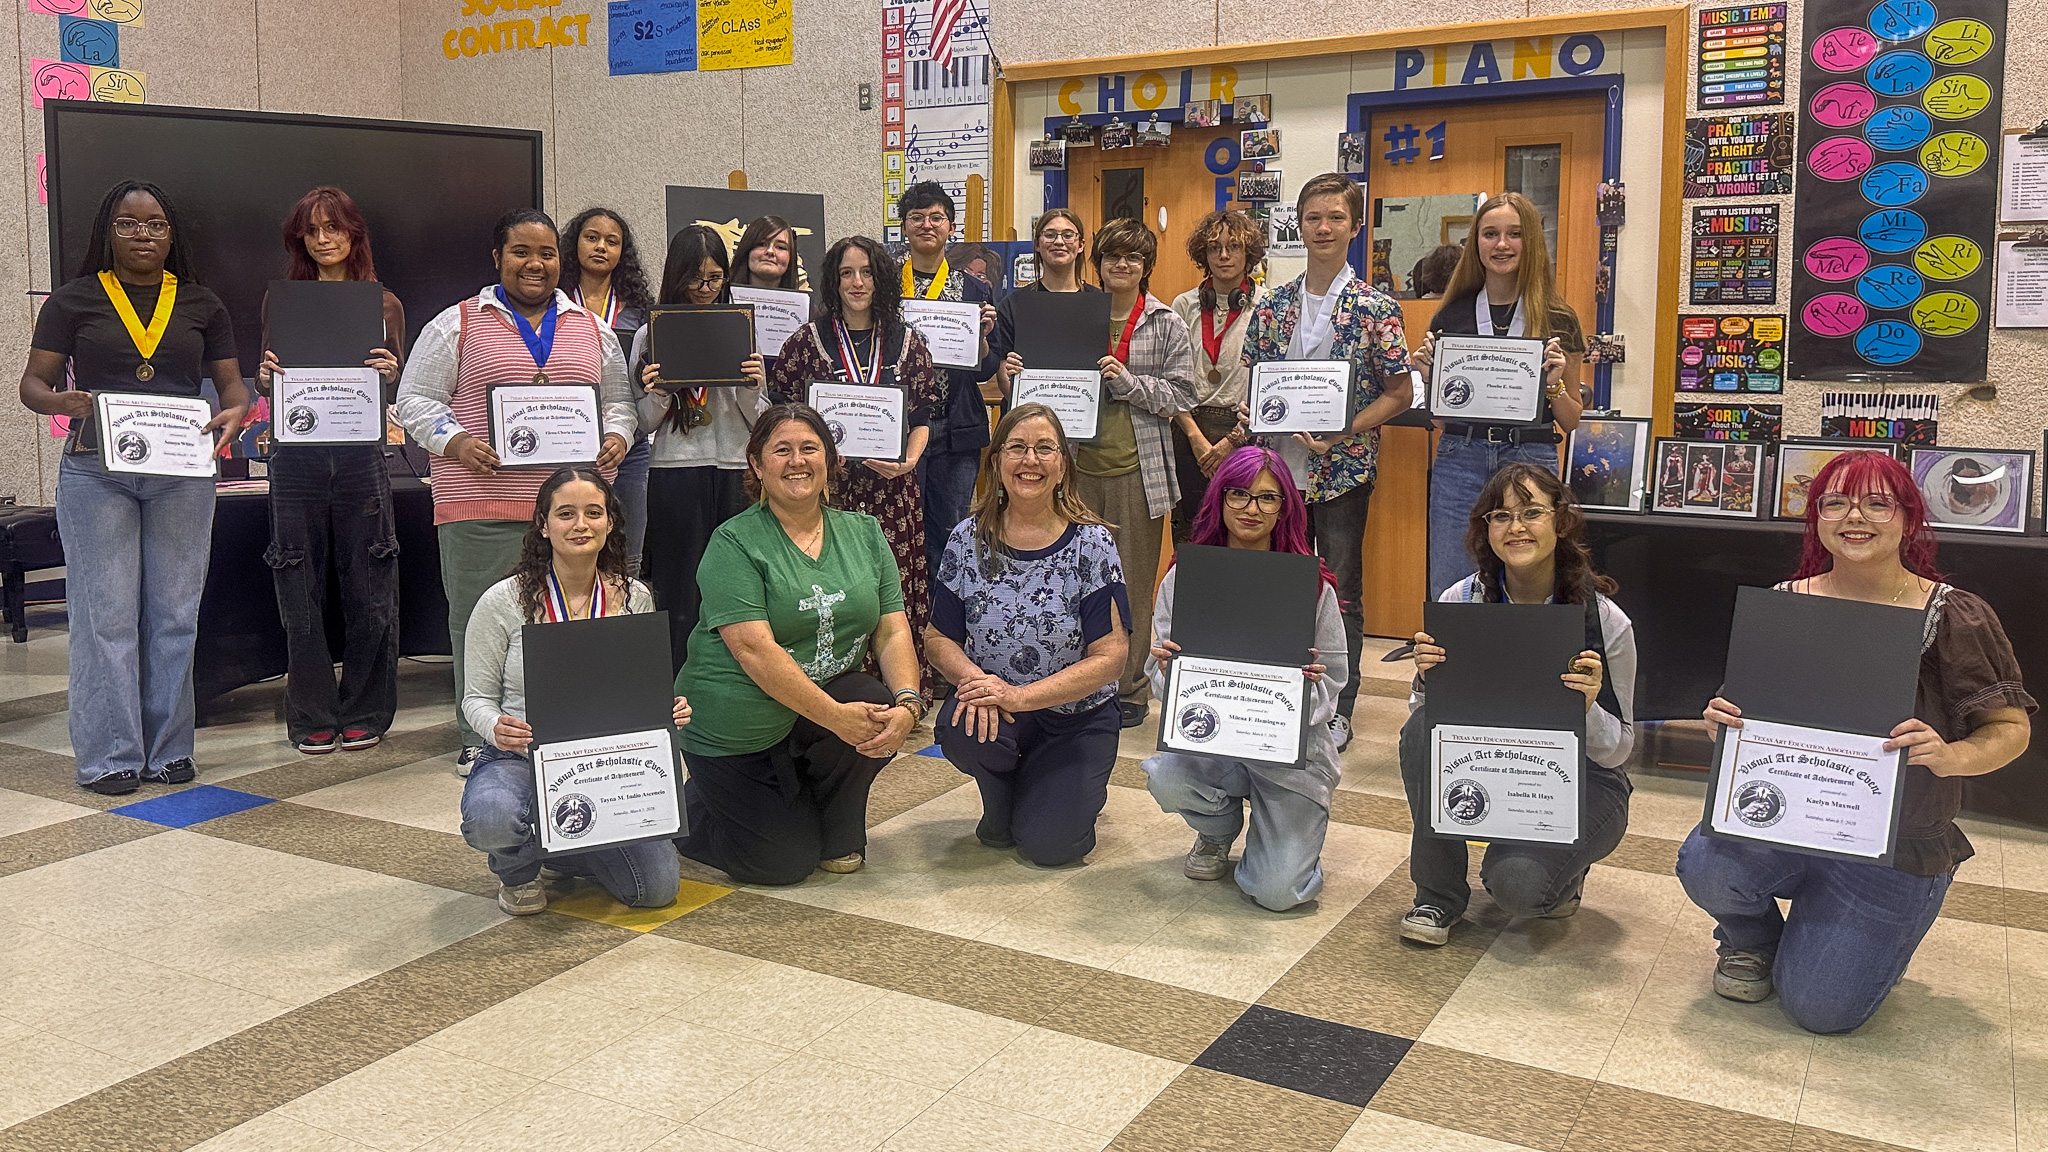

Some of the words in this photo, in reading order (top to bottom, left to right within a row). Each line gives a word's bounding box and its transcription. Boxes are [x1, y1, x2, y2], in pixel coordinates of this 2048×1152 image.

[1701, 10, 1740, 25] MUSIC
[1743, 6, 1785, 21] TEMPO
[1902, 2, 1920, 16] Ti
[443, 13, 591, 60] CONTRACT
[1961, 25, 1980, 39] Li
[1849, 33, 1866, 46] Te
[82, 45, 100, 60] La
[1394, 33, 1605, 91] PIANO
[108, 74, 122, 88] Si
[1892, 79, 1914, 92] La
[1940, 80, 1959, 94] Si
[1058, 65, 1238, 115] CHOIR
[1891, 109, 1913, 122] So
[1707, 121, 1769, 137] PRACTICE
[1383, 120, 1447, 165] #1
[1709, 137, 1729, 146] UNTIL
[1730, 136, 1744, 144] YOU
[1745, 135, 1759, 143] GET
[1958, 137, 1977, 151] Fi
[1722, 144, 1754, 157] RIGHT
[1707, 160, 1769, 175] PRACTICE
[1846, 159, 1866, 173] Se
[1697, 175, 1717, 183] UNTIL
[1733, 174, 1754, 182] CAN'T
[1771, 172, 1778, 180] IT
[1716, 182, 1760, 195] WRONG!
[1899, 178, 1923, 193] Fa
[1711, 217, 1760, 233] MUSIC
[1881, 212, 1906, 227] Mi
[1950, 244, 1973, 258] Ri
[1890, 272, 1917, 286] Re
[1835, 302, 1859, 315] Ra
[1943, 299, 1967, 313] Di
[1877, 324, 1905, 339] Do
[1716, 340, 1745, 353] WHY
[1443, 358, 1465, 373] Visual
[1481, 354, 1518, 365] Scholastic
[1519, 362, 1536, 379] Event
[1706, 355, 1754, 368] MUSIC?
[1707, 409, 1749, 423] SORRY
[190, 419, 203, 431] Eve
[1849, 421, 1905, 438] MUSIC
[1705, 431, 1749, 440] NOISE
[1180, 681, 1208, 699] Visual
[1210, 680, 1225, 688] Art
[1228, 680, 1273, 696] Scholastic
[1274, 692, 1295, 712] Event
[1204, 692, 1232, 700] Certificate
[1255, 718, 1286, 727] Hemingway
[1443, 753, 1473, 775] Visual
[1475, 750, 1492, 760] Art
[1494, 749, 1545, 766] Scholastic
[1547, 761, 1572, 784] Event
[1469, 765, 1500, 773] Certificate
[1509, 768, 1547, 776] Achievement
[549, 768, 576, 793] Visual
[579, 762, 594, 774] Art
[596, 757, 642, 768] Scholastic
[645, 759, 667, 779] Event
[574, 776, 602, 785] Certificate
[611, 770, 645, 780] Achievement
[1738, 755, 1773, 775] Visual
[1776, 754, 1795, 763] Art
[1798, 754, 1855, 775] Scholastic
[1856, 771, 1882, 795] Event
[1768, 767, 1802, 778] Certificate
[1812, 774, 1855, 786] Achievement
[1507, 791, 1530, 799] Isabella
[1538, 793, 1554, 801] Hays
[1806, 797, 1830, 807] Kaelyn
[1831, 801, 1860, 810] Maxwell
